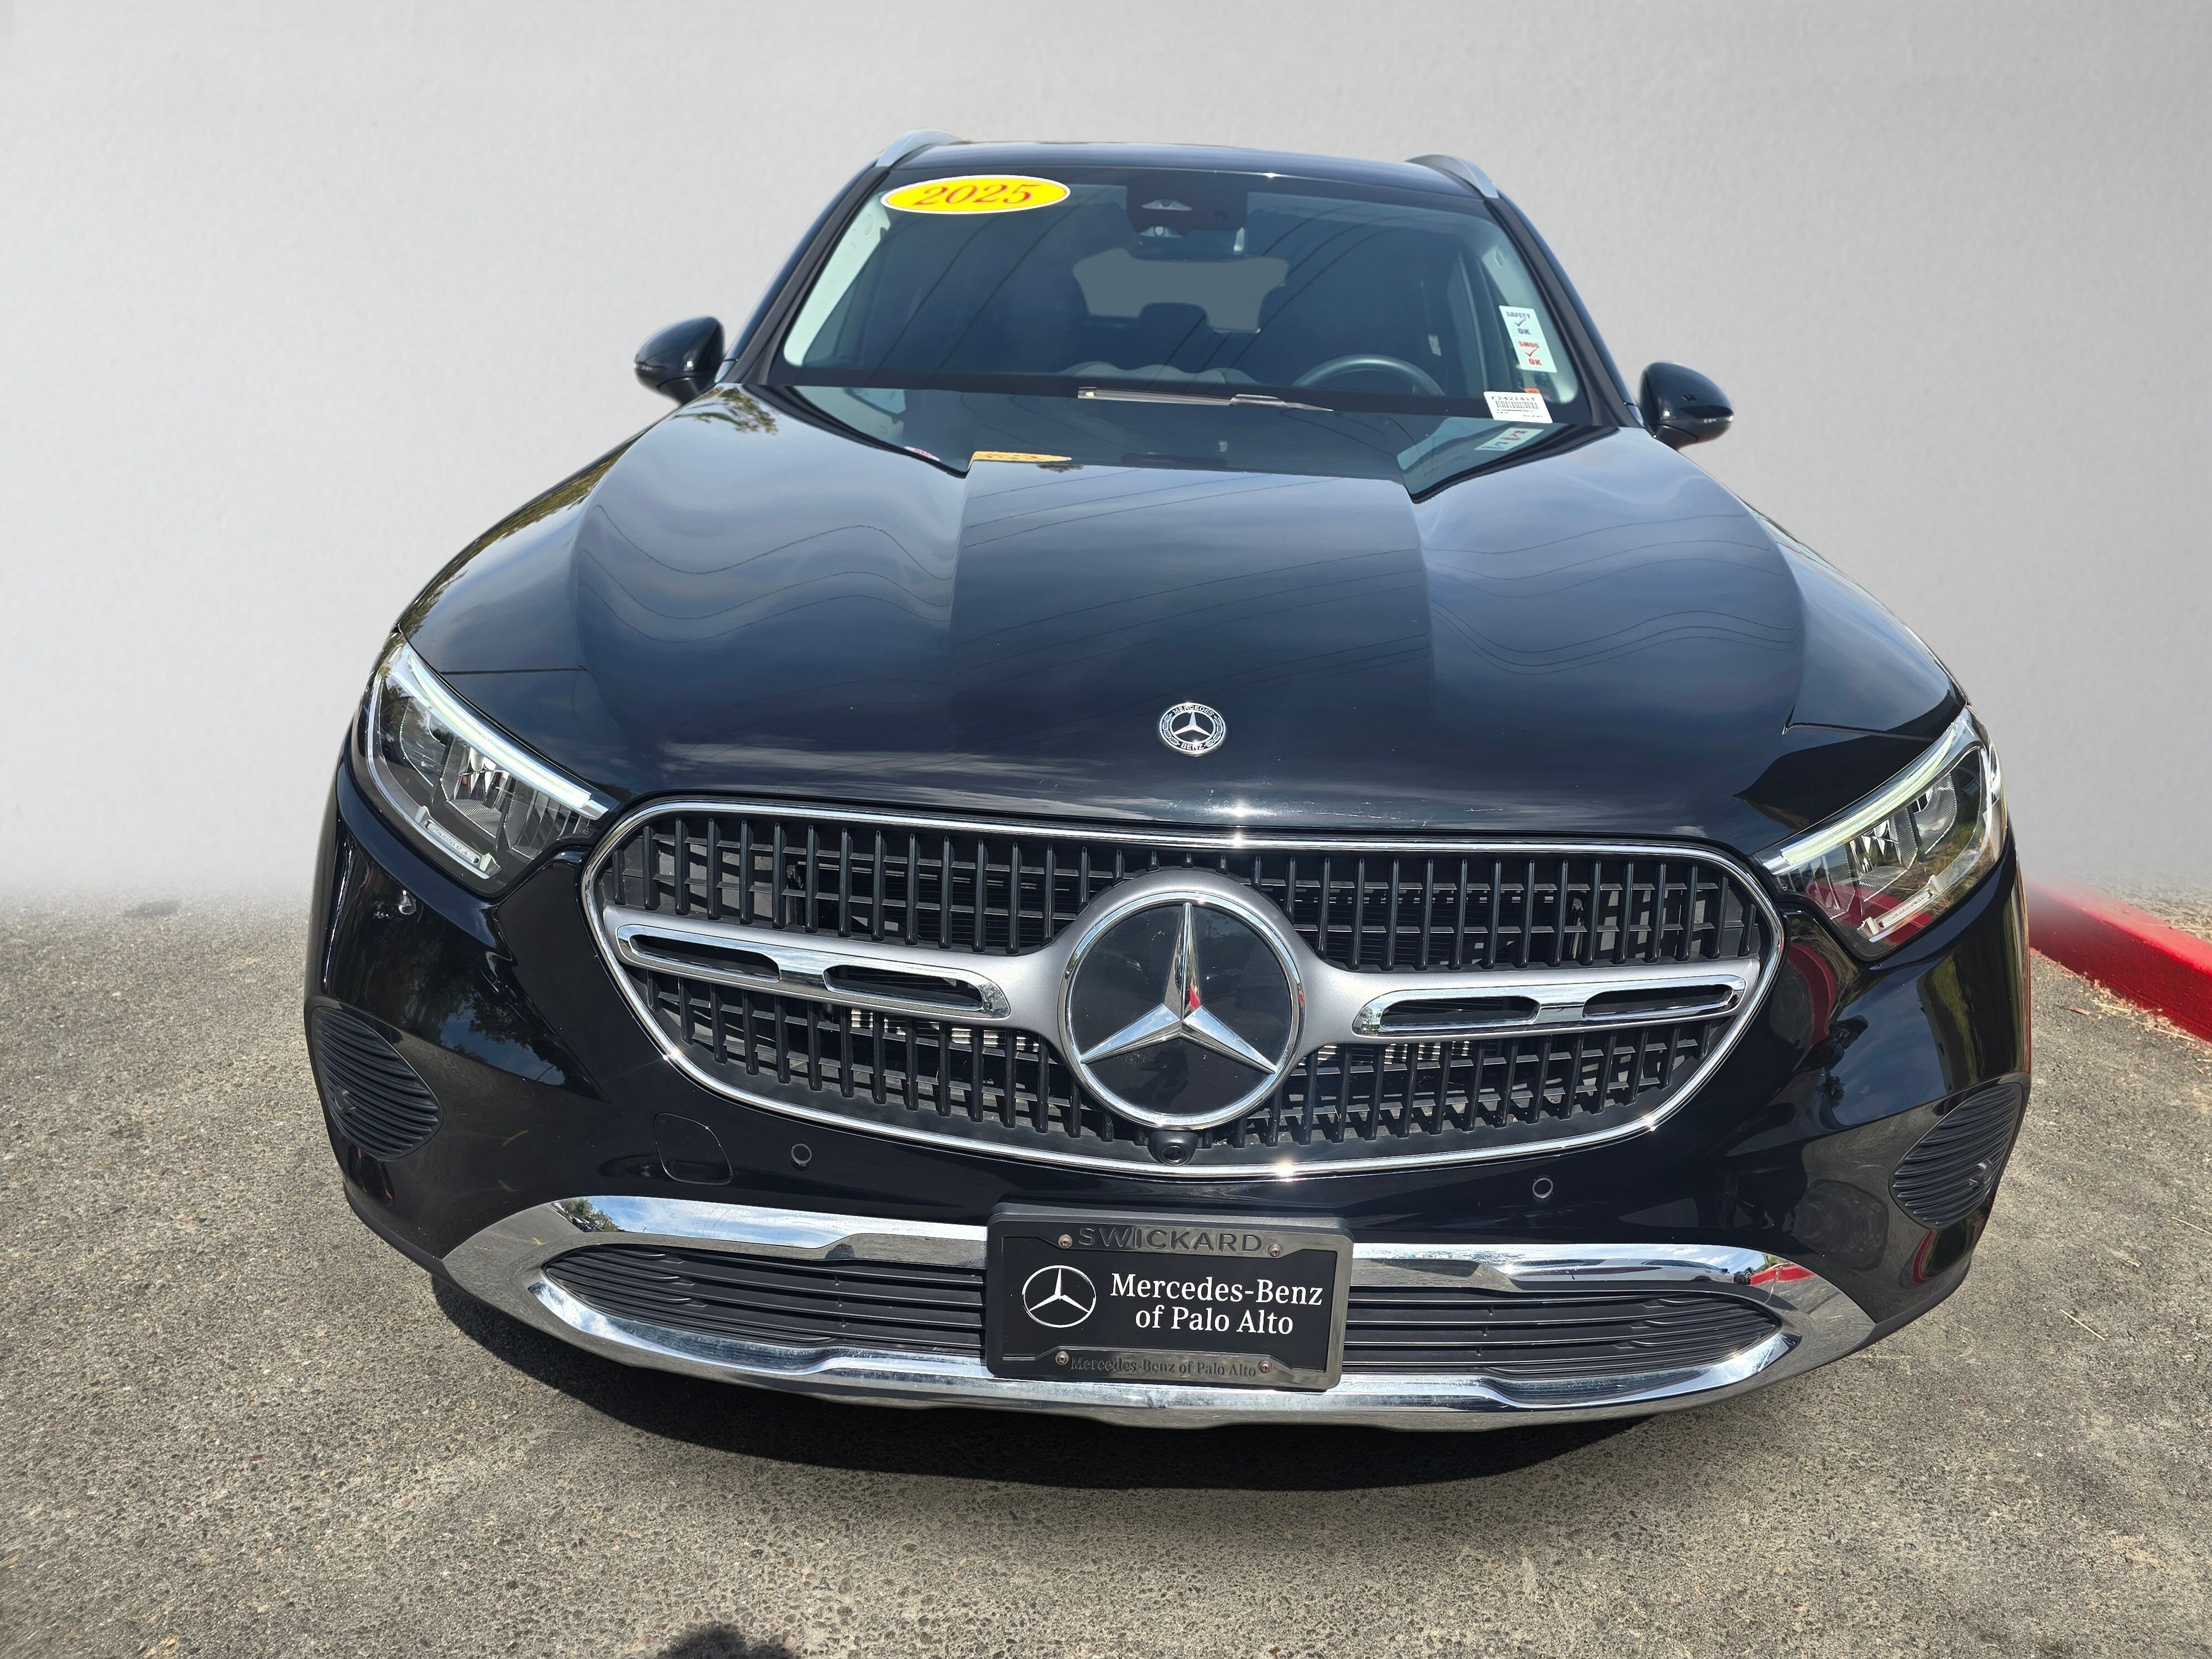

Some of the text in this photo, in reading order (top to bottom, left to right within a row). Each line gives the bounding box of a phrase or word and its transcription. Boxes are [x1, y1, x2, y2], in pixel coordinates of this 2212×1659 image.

[913, 184, 1040, 205] 2025
[1172, 705, 1214, 716] MERCEDES
[1078, 1227, 1262, 1251] SWICKARD
[1110, 1273, 1323, 1306] Mercedes-Benz
[1135, 1305, 1293, 1334] of Palo Alto
[1071, 1358, 1256, 1377] Mercedes-Benz of Palo Alto
